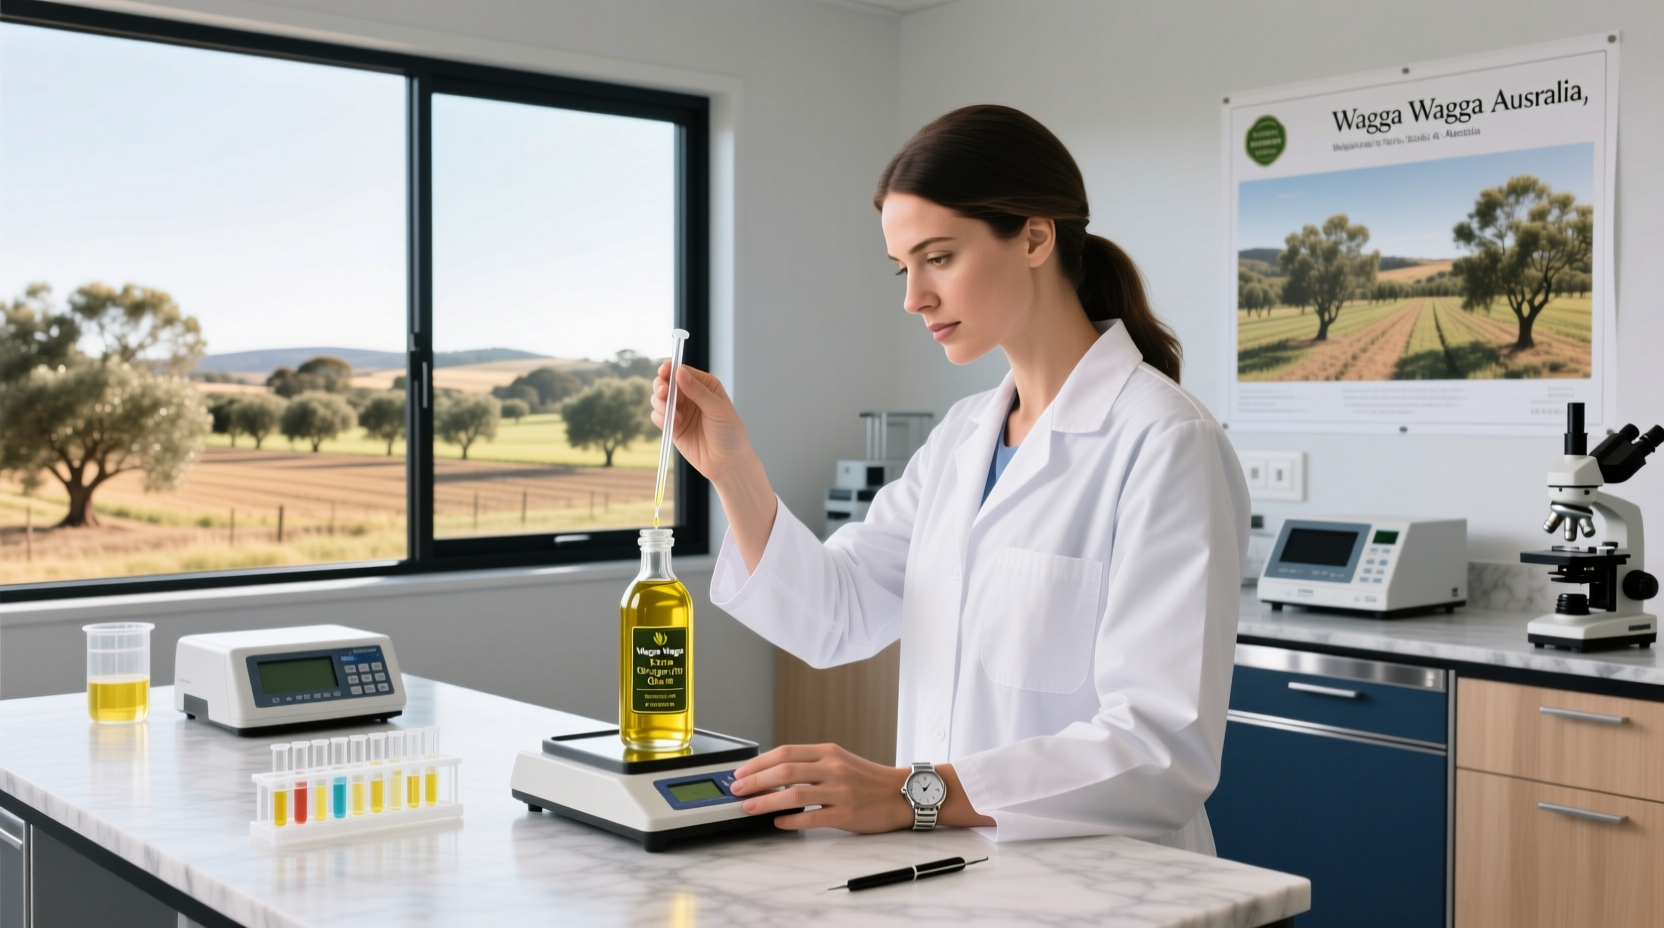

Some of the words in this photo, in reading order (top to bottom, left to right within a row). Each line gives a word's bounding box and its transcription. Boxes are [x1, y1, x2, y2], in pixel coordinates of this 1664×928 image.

[1332, 108, 1403, 135] Wagga
[1408, 98, 1484, 125] Wagga
[1490, 79, 1589, 113] Ausralia,
